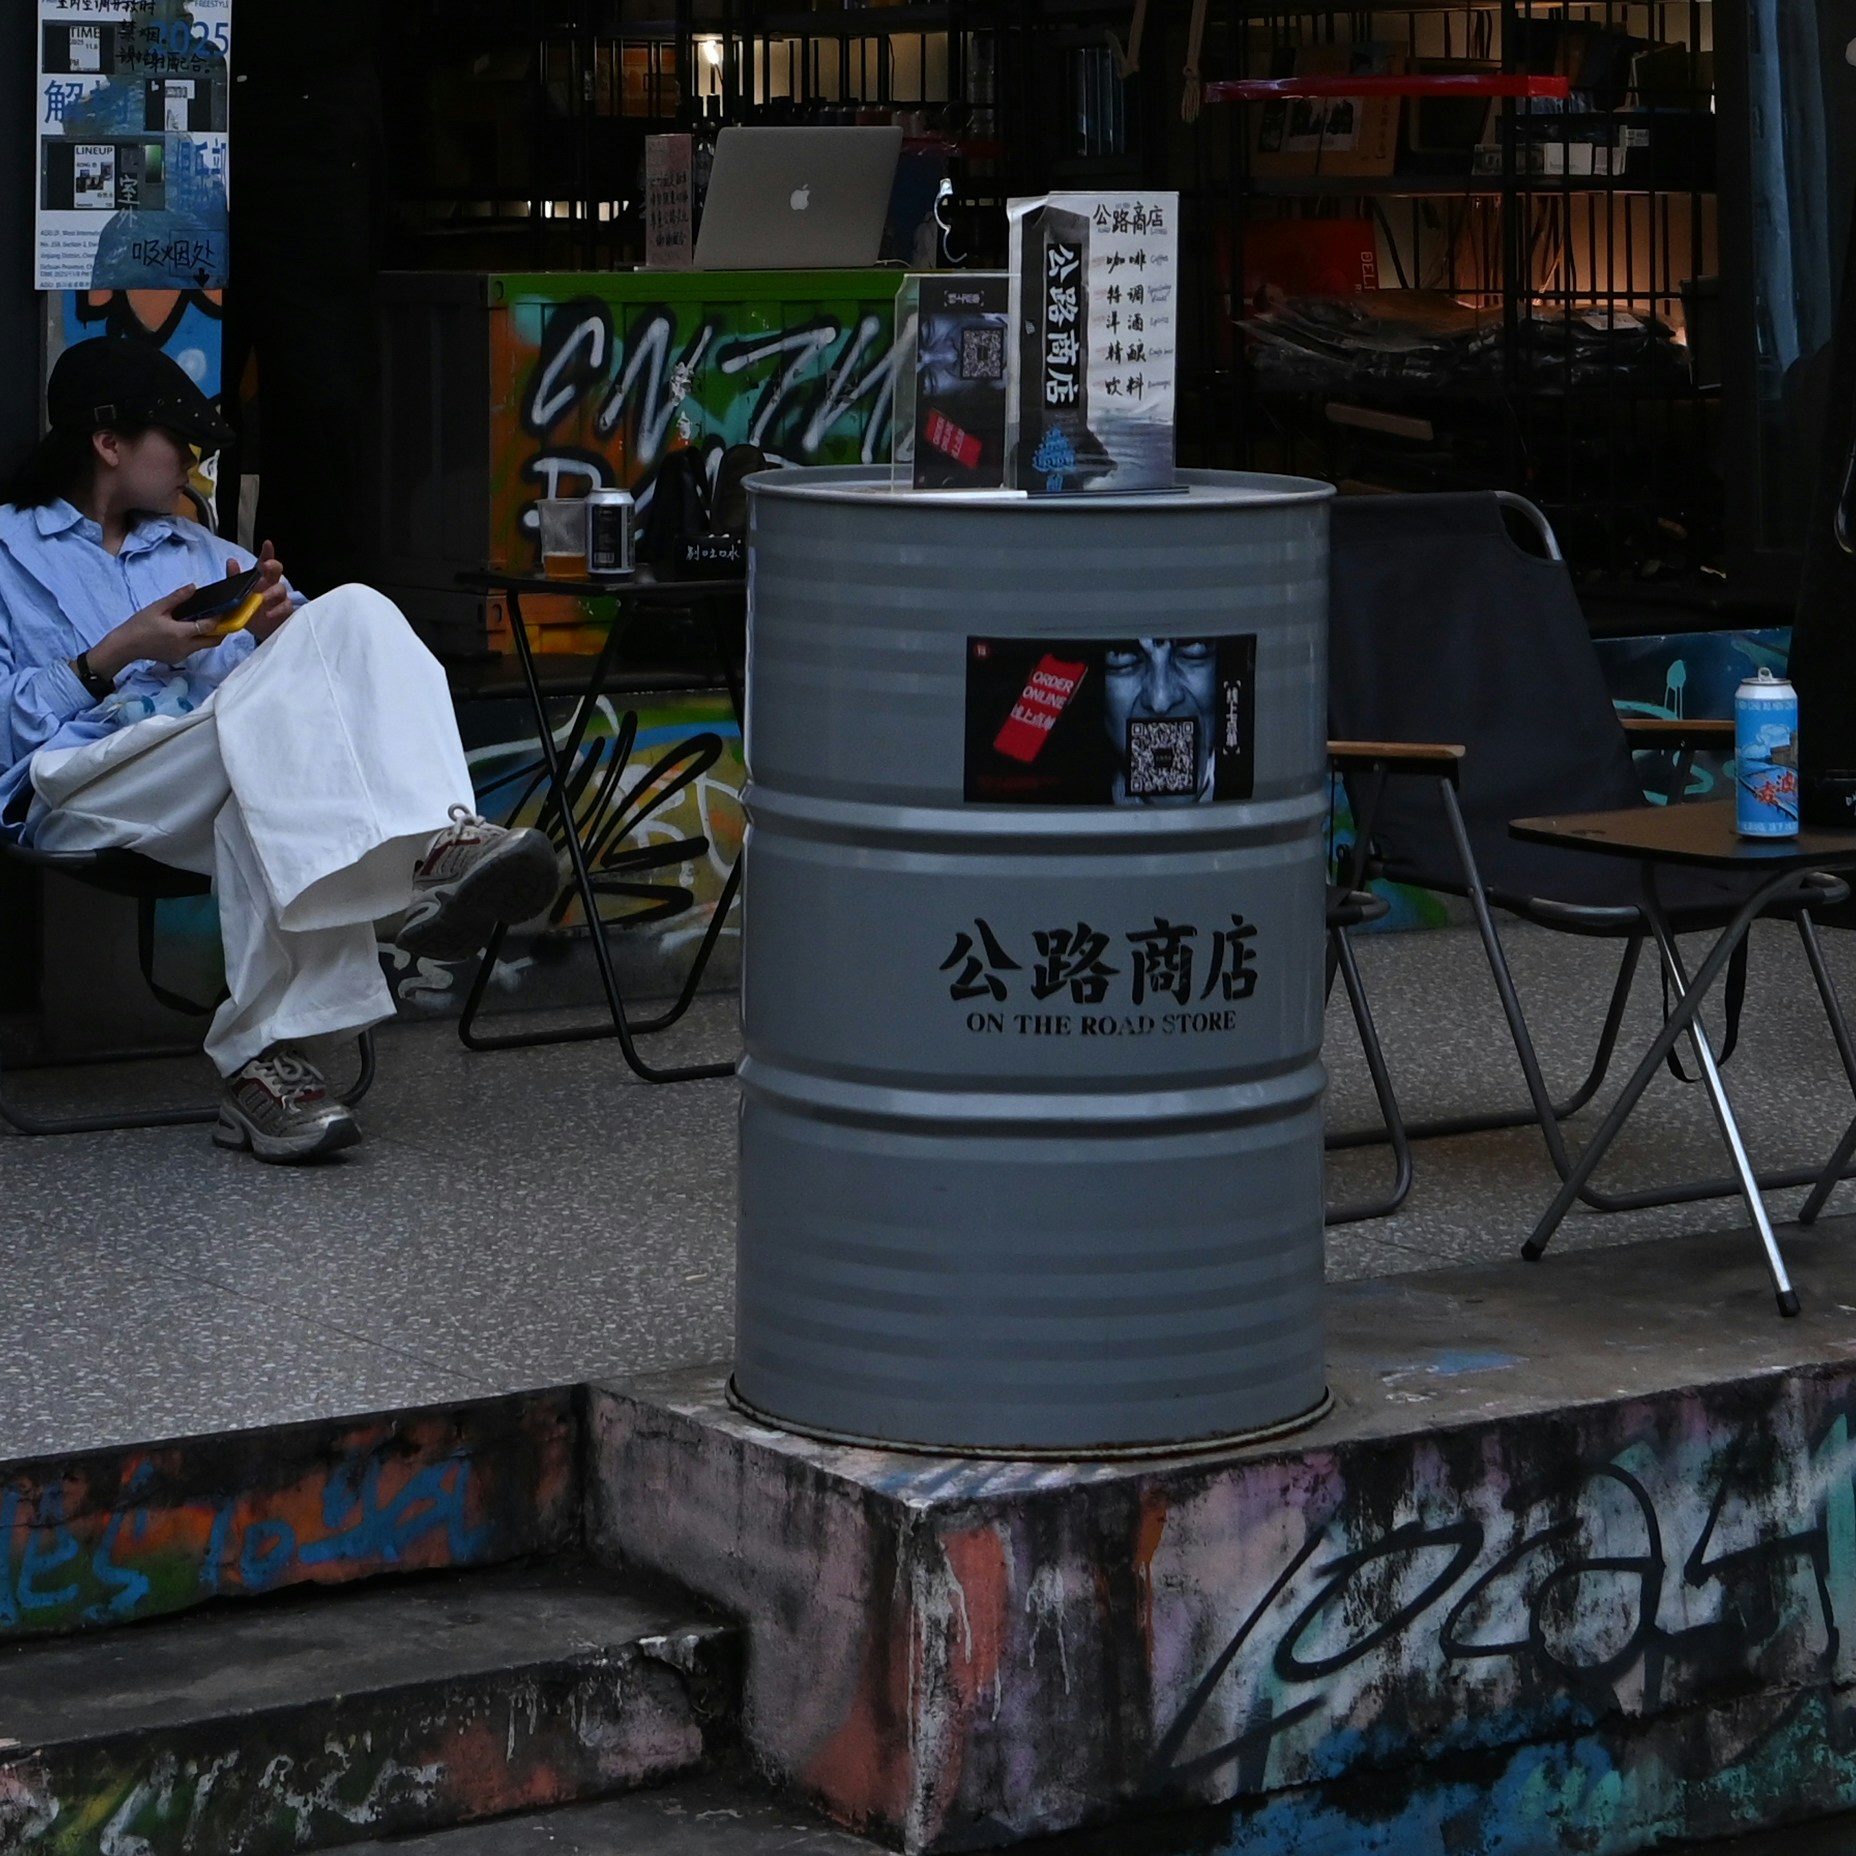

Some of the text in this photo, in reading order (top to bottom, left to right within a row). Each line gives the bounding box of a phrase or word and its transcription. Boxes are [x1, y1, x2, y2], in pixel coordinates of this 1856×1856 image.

[70, 27, 101, 39] TIME
[76, 146, 114, 156] LINEUP
[1093, 201, 1164, 236] 公路商店
[132, 238, 216, 269] 吸烟处
[1106, 249, 1147, 274] 咖啡
[1046, 243, 1080, 405] 公路商店
[1105, 372, 1144, 401] 饮料
[1032, 671, 1075, 693] ORDER
[1022, 685, 1068, 711] ONLINE
[939, 913, 1258, 1006] 公路商店
[966, 1010, 1237, 1036] ON THE ROAD STORE
